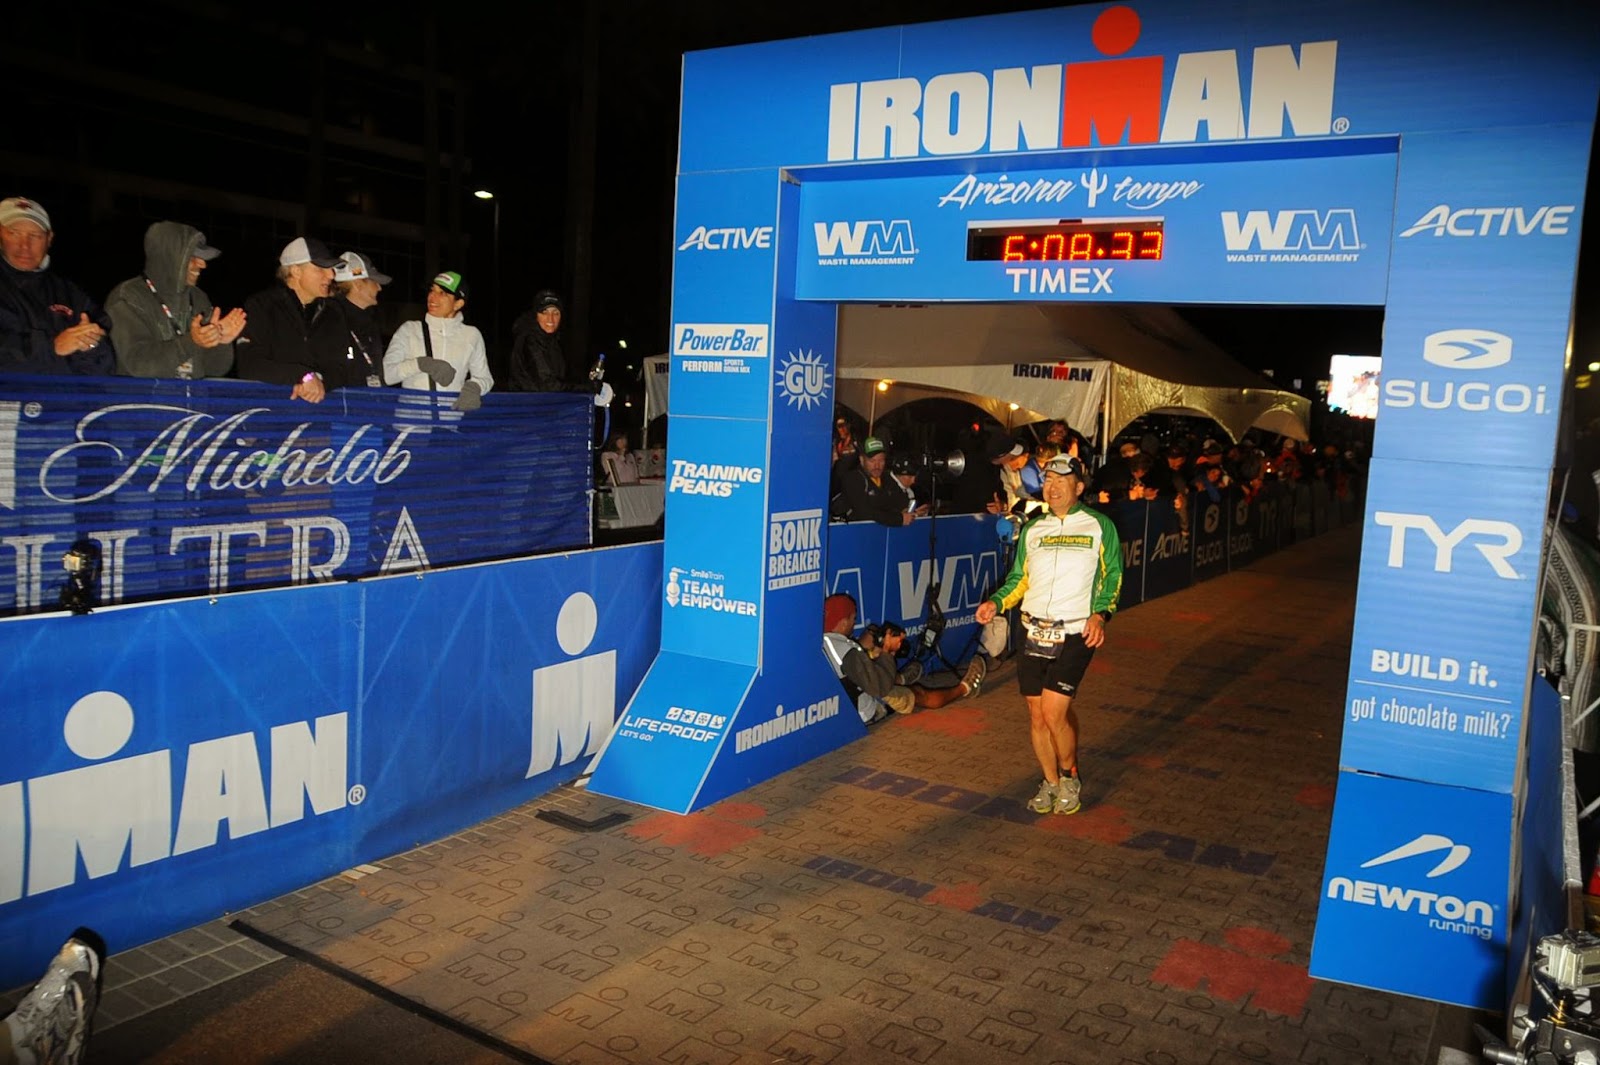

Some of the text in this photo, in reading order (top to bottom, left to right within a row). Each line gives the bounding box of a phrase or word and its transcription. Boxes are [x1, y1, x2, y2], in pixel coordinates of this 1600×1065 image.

[827, 5, 1338, 162] IRONMAN
[938, 172, 1204, 211] Arizona tempe
[1221, 208, 1360, 251] WM
[1399, 204, 1575, 238] ACTIVE
[678, 226, 773, 251] ACTIVE
[813, 219, 914, 256] WM
[850, 257, 914, 265] MANAGEMENT
[1226, 253, 1359, 262] WASTE MANAGEMENT
[1005, 268, 1114, 293] TIMEX
[679, 328, 764, 352] PowerBar
[682, 360, 722, 373] PERFORM
[785, 363, 824, 395] GU
[1013, 361, 1093, 382] IRONMAN
[39, 403, 430, 501] Michelob
[672, 460, 763, 483] TRAINING
[669, 476, 734, 497] PEAKS
[769, 519, 822, 555] BONK
[1374, 511, 1521, 580] TYR
[690, 569, 725, 580] SmileTrain
[769, 550, 821, 577] BREAKER
[682, 579, 724, 597] TEAM
[681, 595, 757, 616] EMPOWER
[1032, 627, 1062, 640] 2675
[1370, 649, 1498, 688] BUILD it.
[624, 715, 720, 743] LIFEPROOF
[735, 695, 839, 754] IRONMAN.COM
[1351, 696, 1511, 738] got chocolate milk?
[1429, 917, 1492, 940] running
